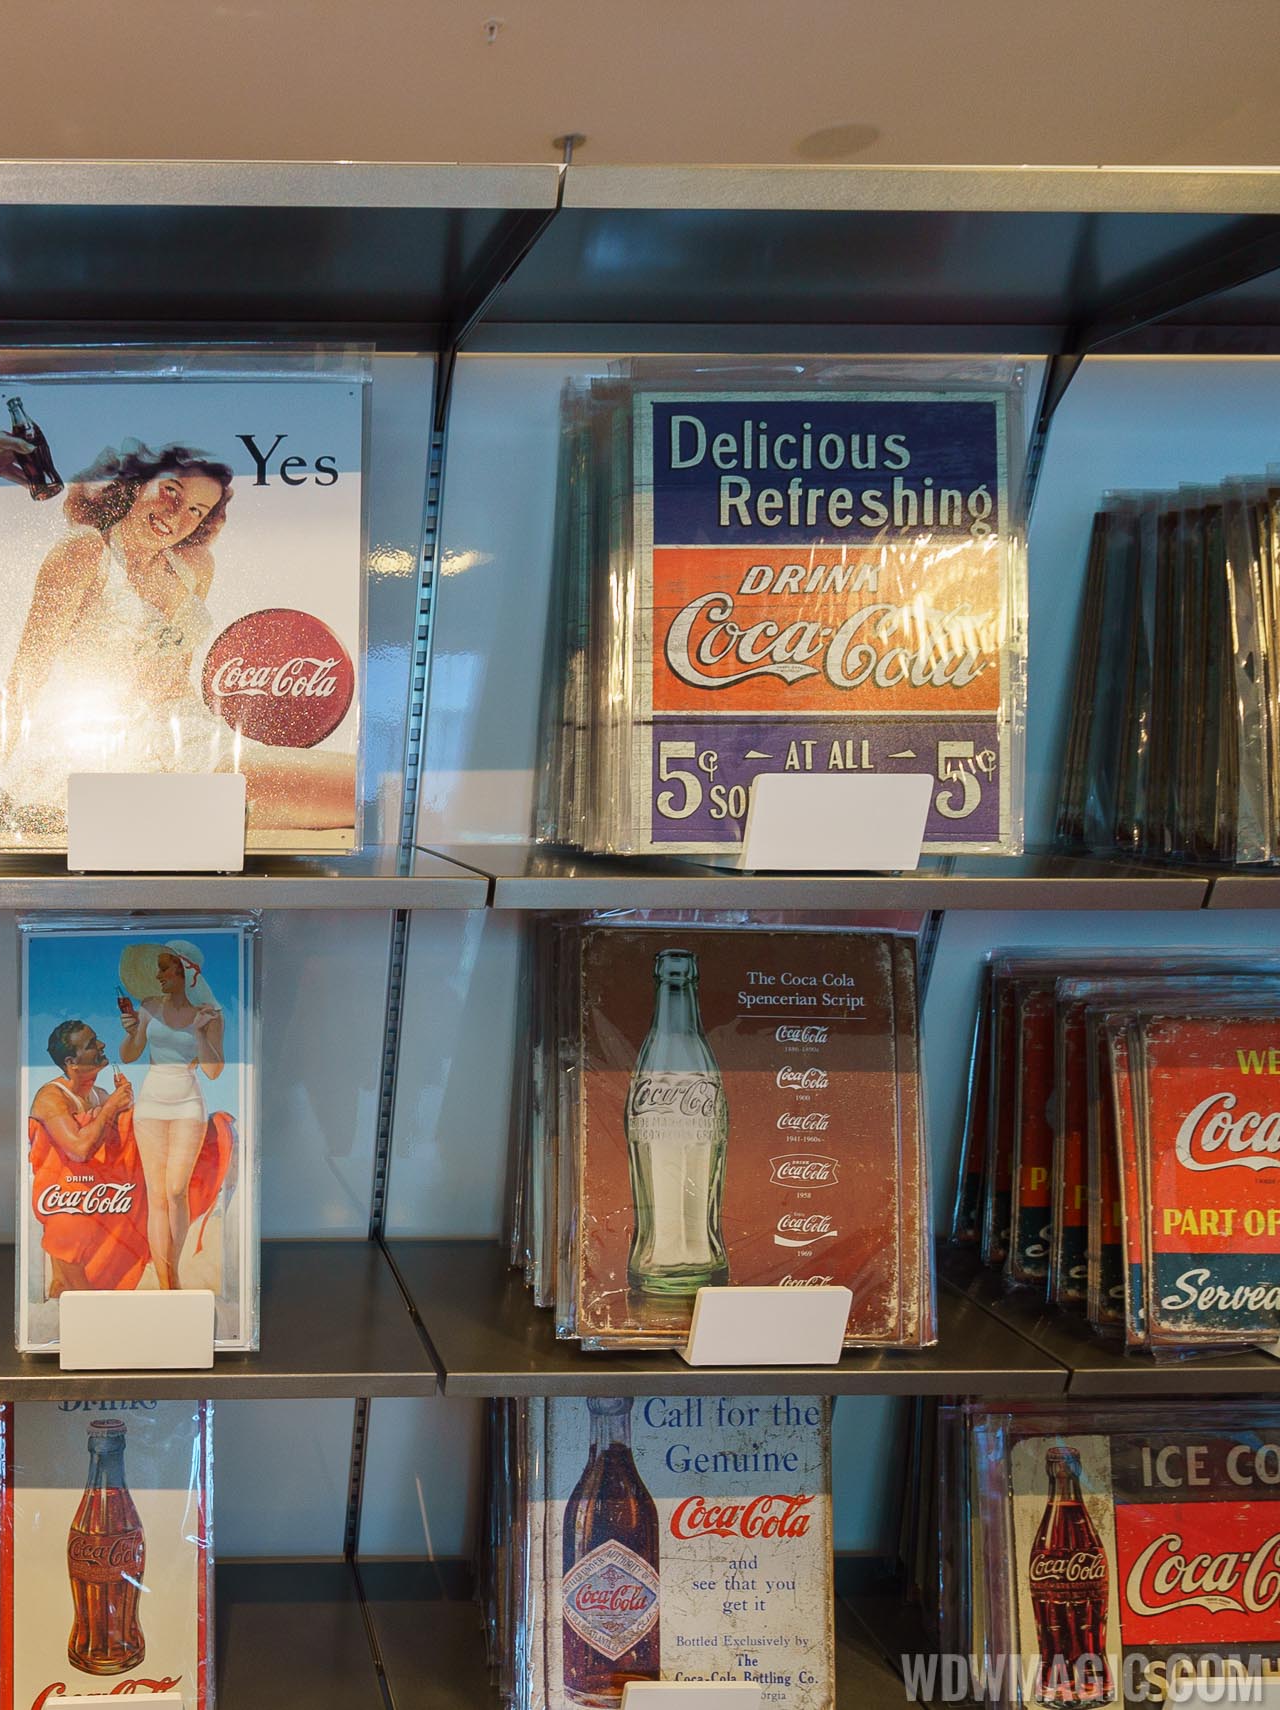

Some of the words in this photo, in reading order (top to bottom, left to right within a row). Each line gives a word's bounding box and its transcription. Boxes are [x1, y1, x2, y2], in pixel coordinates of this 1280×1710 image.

[670, 414, 911, 471] Delicious
[235, 434, 339, 487] Yes
[719, 475, 993, 537] Refreshing
[739, 565, 882, 595] DRINK
[665, 592, 992, 691] Coca-Cola
[211, 656, 341, 699] Coca-Cola
[785, 740, 818, 770] AT
[828, 739, 875, 770] ALL
[710, 784, 752, 819] SO
[746, 971, 776, 985] The
[737, 991, 817, 1009] Spencerian
[822, 992, 865, 1010] Script
[775, 1025, 829, 1043] Coca-Cola
[776, 1065, 830, 1090] Coca-Cola
[776, 1112, 831, 1131] Coca-Cola
[65, 1175, 95, 1183] DRINK
[777, 1161, 832, 1180] Coca-Cola
[37, 1181, 136, 1215] Coca-Cola
[777, 1214, 833, 1233] Coca-Cola
[1163, 1208, 1237, 1236] PART
[643, 1396, 703, 1428] Call
[718, 1397, 760, 1428] for
[773, 1396, 820, 1427] the
[665, 1443, 799, 1474] Genuine
[1141, 1446, 1211, 1488] ICE
[669, 1494, 817, 1541] Coca-Cola
[729, 1555, 758, 1570] and
[1029, 1552, 1106, 1581] Coca-Cola
[575, 1583, 648, 1612] Coca-Cola
[692, 1578, 716, 1591] see
[725, 1576, 757, 1591] that
[766, 1578, 796, 1596] you
[722, 1598, 750, 1614] get
[754, 1598, 767, 1612] it
[676, 1635, 718, 1647] Bottled
[723, 1634, 790, 1648] Exclusively
[795, 1635, 809, 1648] by
[735, 1653, 758, 1667] The
[743, 1671, 792, 1687] Bottling
[798, 1671, 819, 1684] Co.
[761, 1691, 787, 1702] orgia
